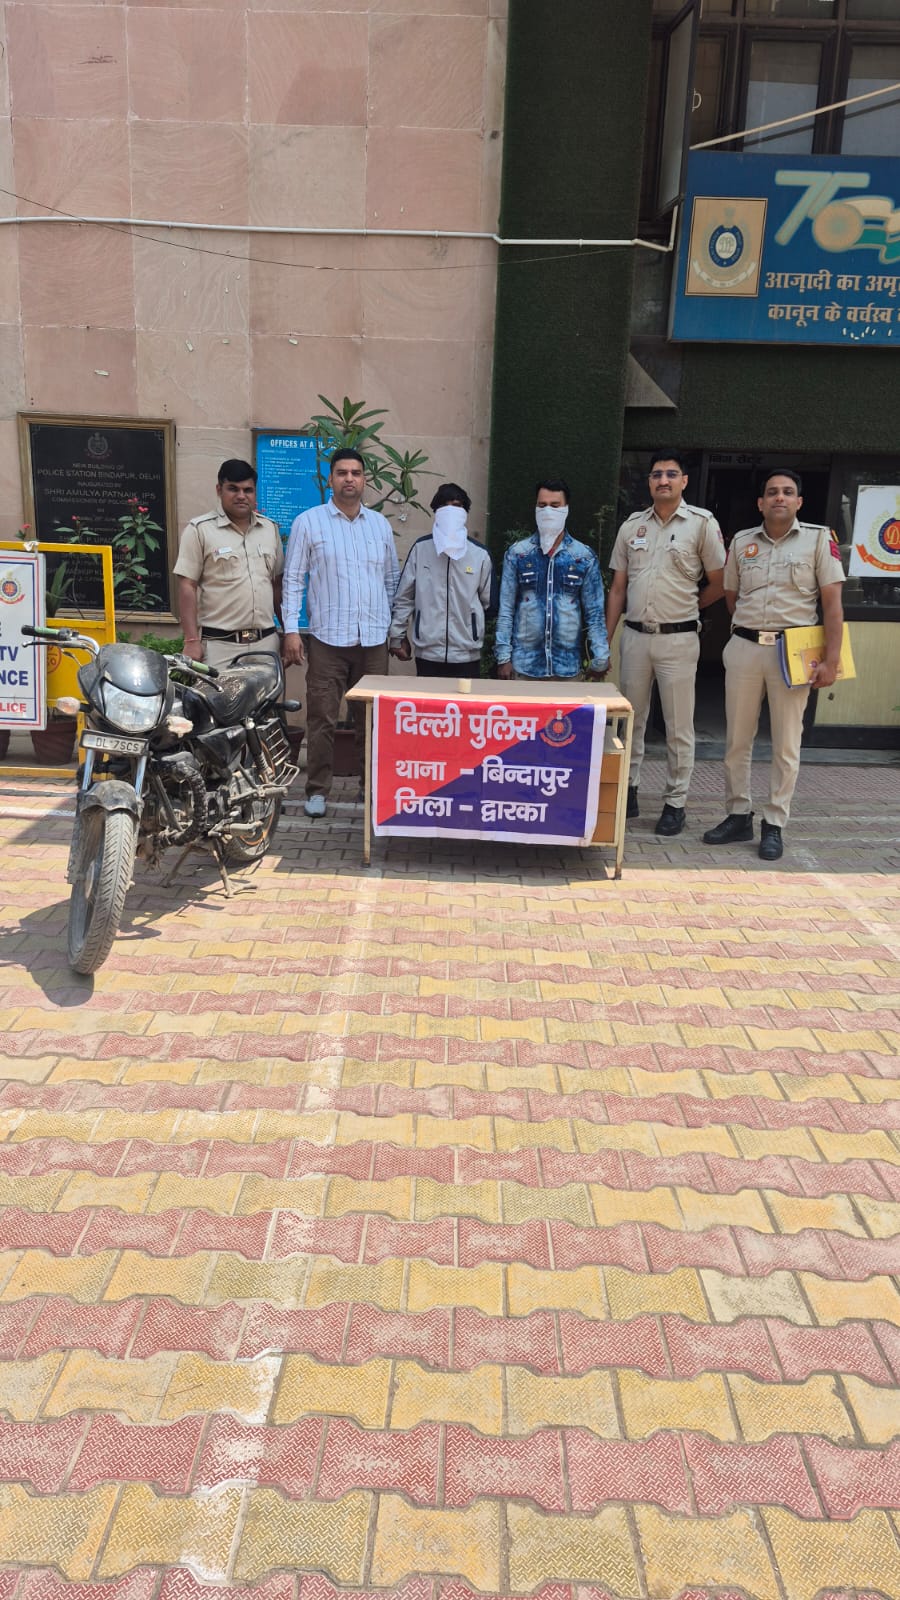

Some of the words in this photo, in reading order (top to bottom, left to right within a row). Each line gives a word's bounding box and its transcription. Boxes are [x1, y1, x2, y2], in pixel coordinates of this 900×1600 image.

[765, 270, 832, 293] आज़ादी
[837, 273, 861, 291] का
[768, 304, 821, 327] कानून
[824, 301, 843, 321] के
[270, 439, 298, 448] OFFICES
[299, 440, 307, 449] AT
[309, 441, 314, 449] A
[38, 468, 64, 477] POLICE
[65, 470, 96, 478] STATION
[139, 473, 161, 481] DELHI
[44, 488, 65, 496] SHRI
[66, 489, 101, 498] AMULYA
[142, 492, 156, 500] IPS
[394, 701, 462, 738] दिल्ली
[468, 704, 539, 749] पुलिस
[96, 737, 108, 748] DL
[395, 760, 447, 781] थाना
[481, 755, 573, 797] बिन्दापुर
[394, 787, 453, 817] जिला
[481, 799, 549, 823] द्वारका
